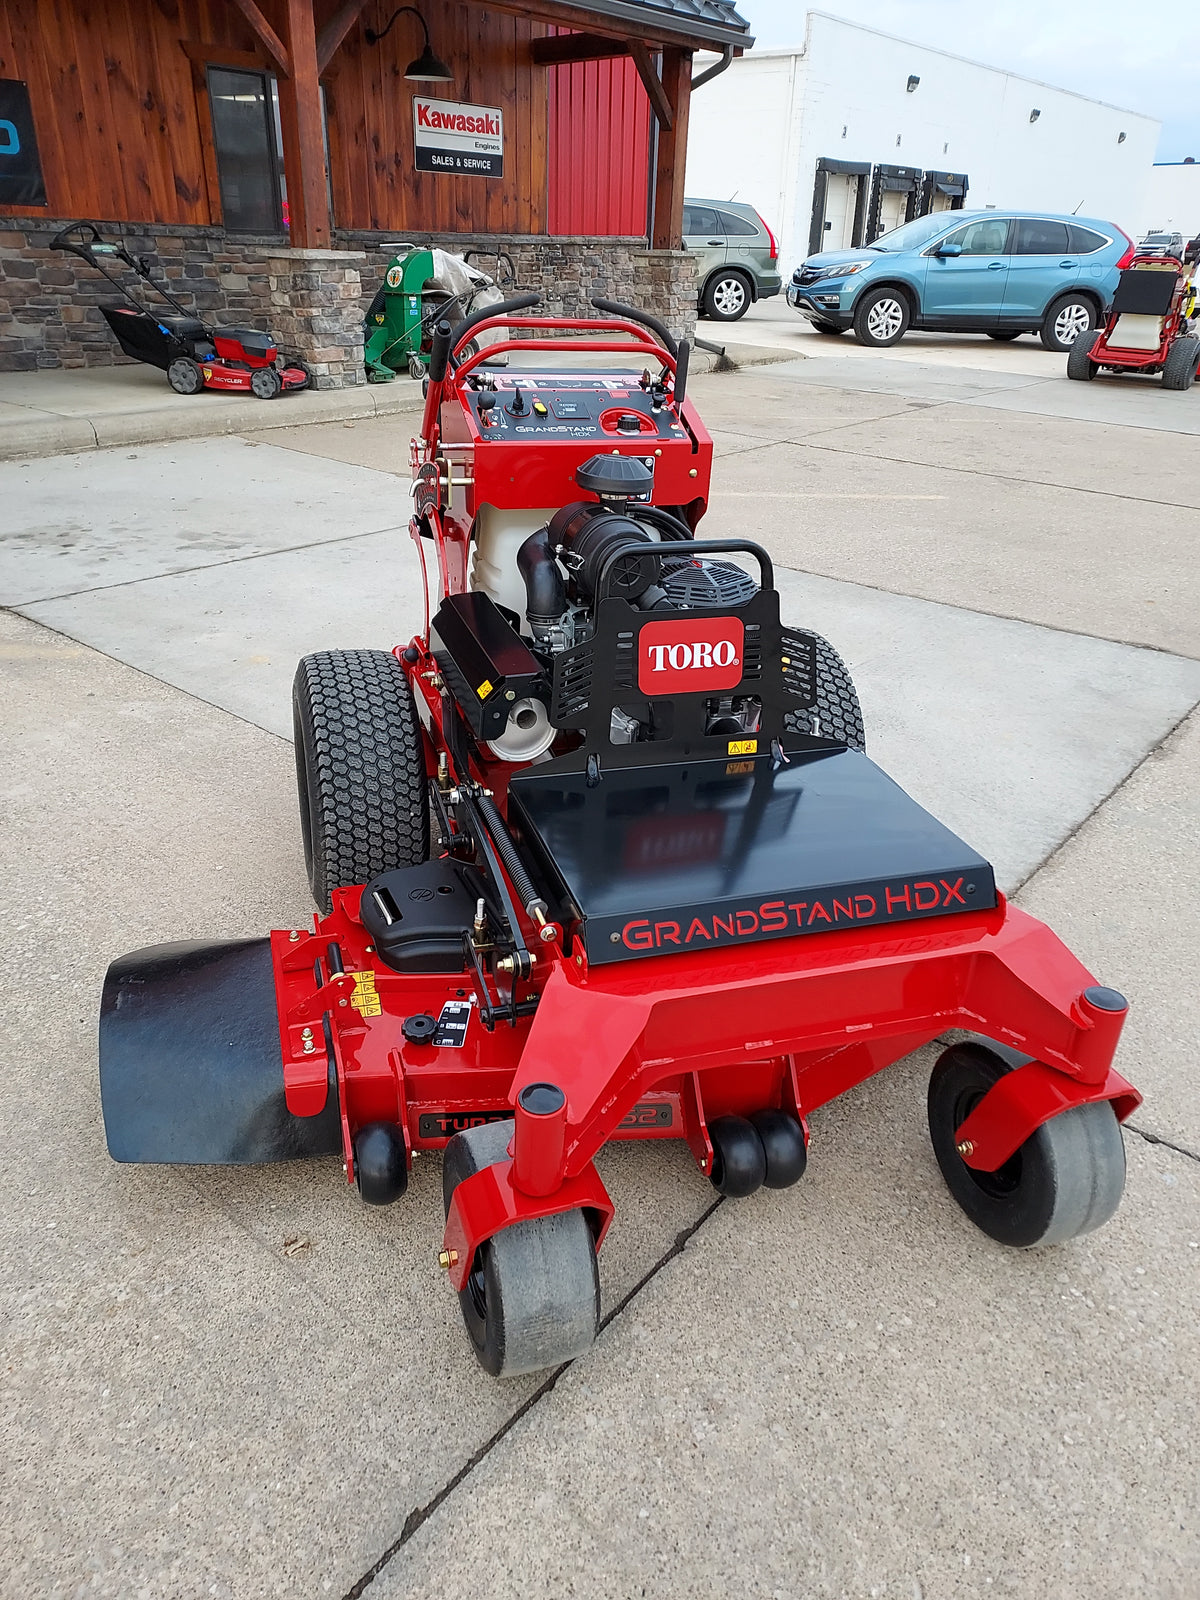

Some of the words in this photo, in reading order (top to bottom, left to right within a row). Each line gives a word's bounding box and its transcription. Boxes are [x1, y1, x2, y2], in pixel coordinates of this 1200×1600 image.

[417, 103, 500, 135] Kawasaki
[474, 141, 500, 151] Engines
[431, 155, 454, 166] SALES
[456, 158, 461, 167] &
[463, 158, 491, 170] SERVICE
[213, 376, 243, 384] RECYCLER
[648, 640, 736, 672] TORO
[884, 877, 967, 915] HDX
